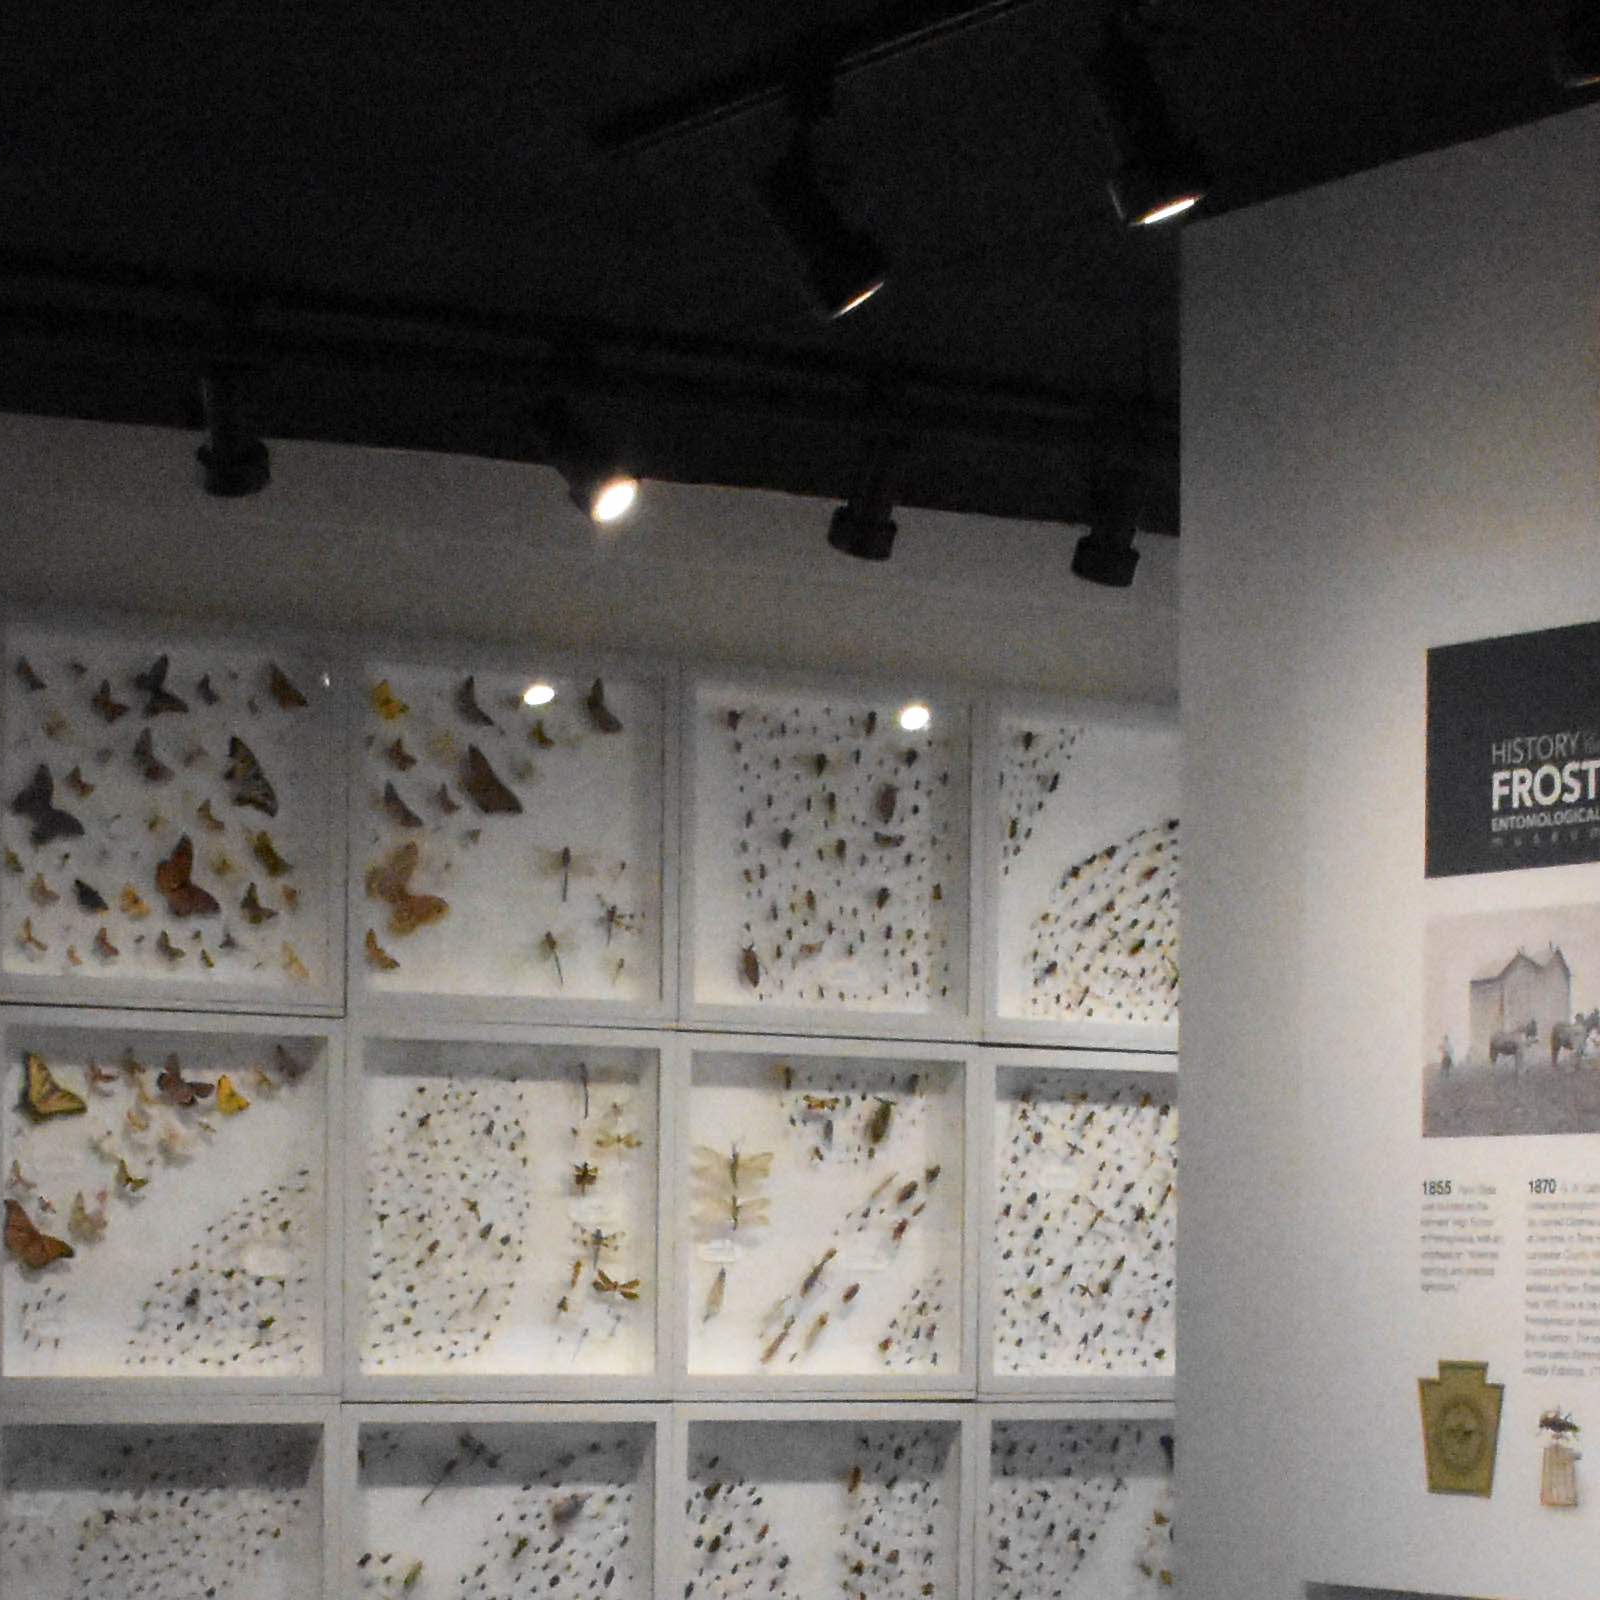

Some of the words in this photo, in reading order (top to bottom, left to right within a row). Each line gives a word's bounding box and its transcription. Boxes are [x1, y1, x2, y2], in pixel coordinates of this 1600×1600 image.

[1491, 731, 1580, 764] HISTORY
[1491, 805, 1600, 832] ENTOMOLOGICAL
[1421, 1180, 1453, 1196] 1855
[1527, 1178, 1557, 1194] 1870
